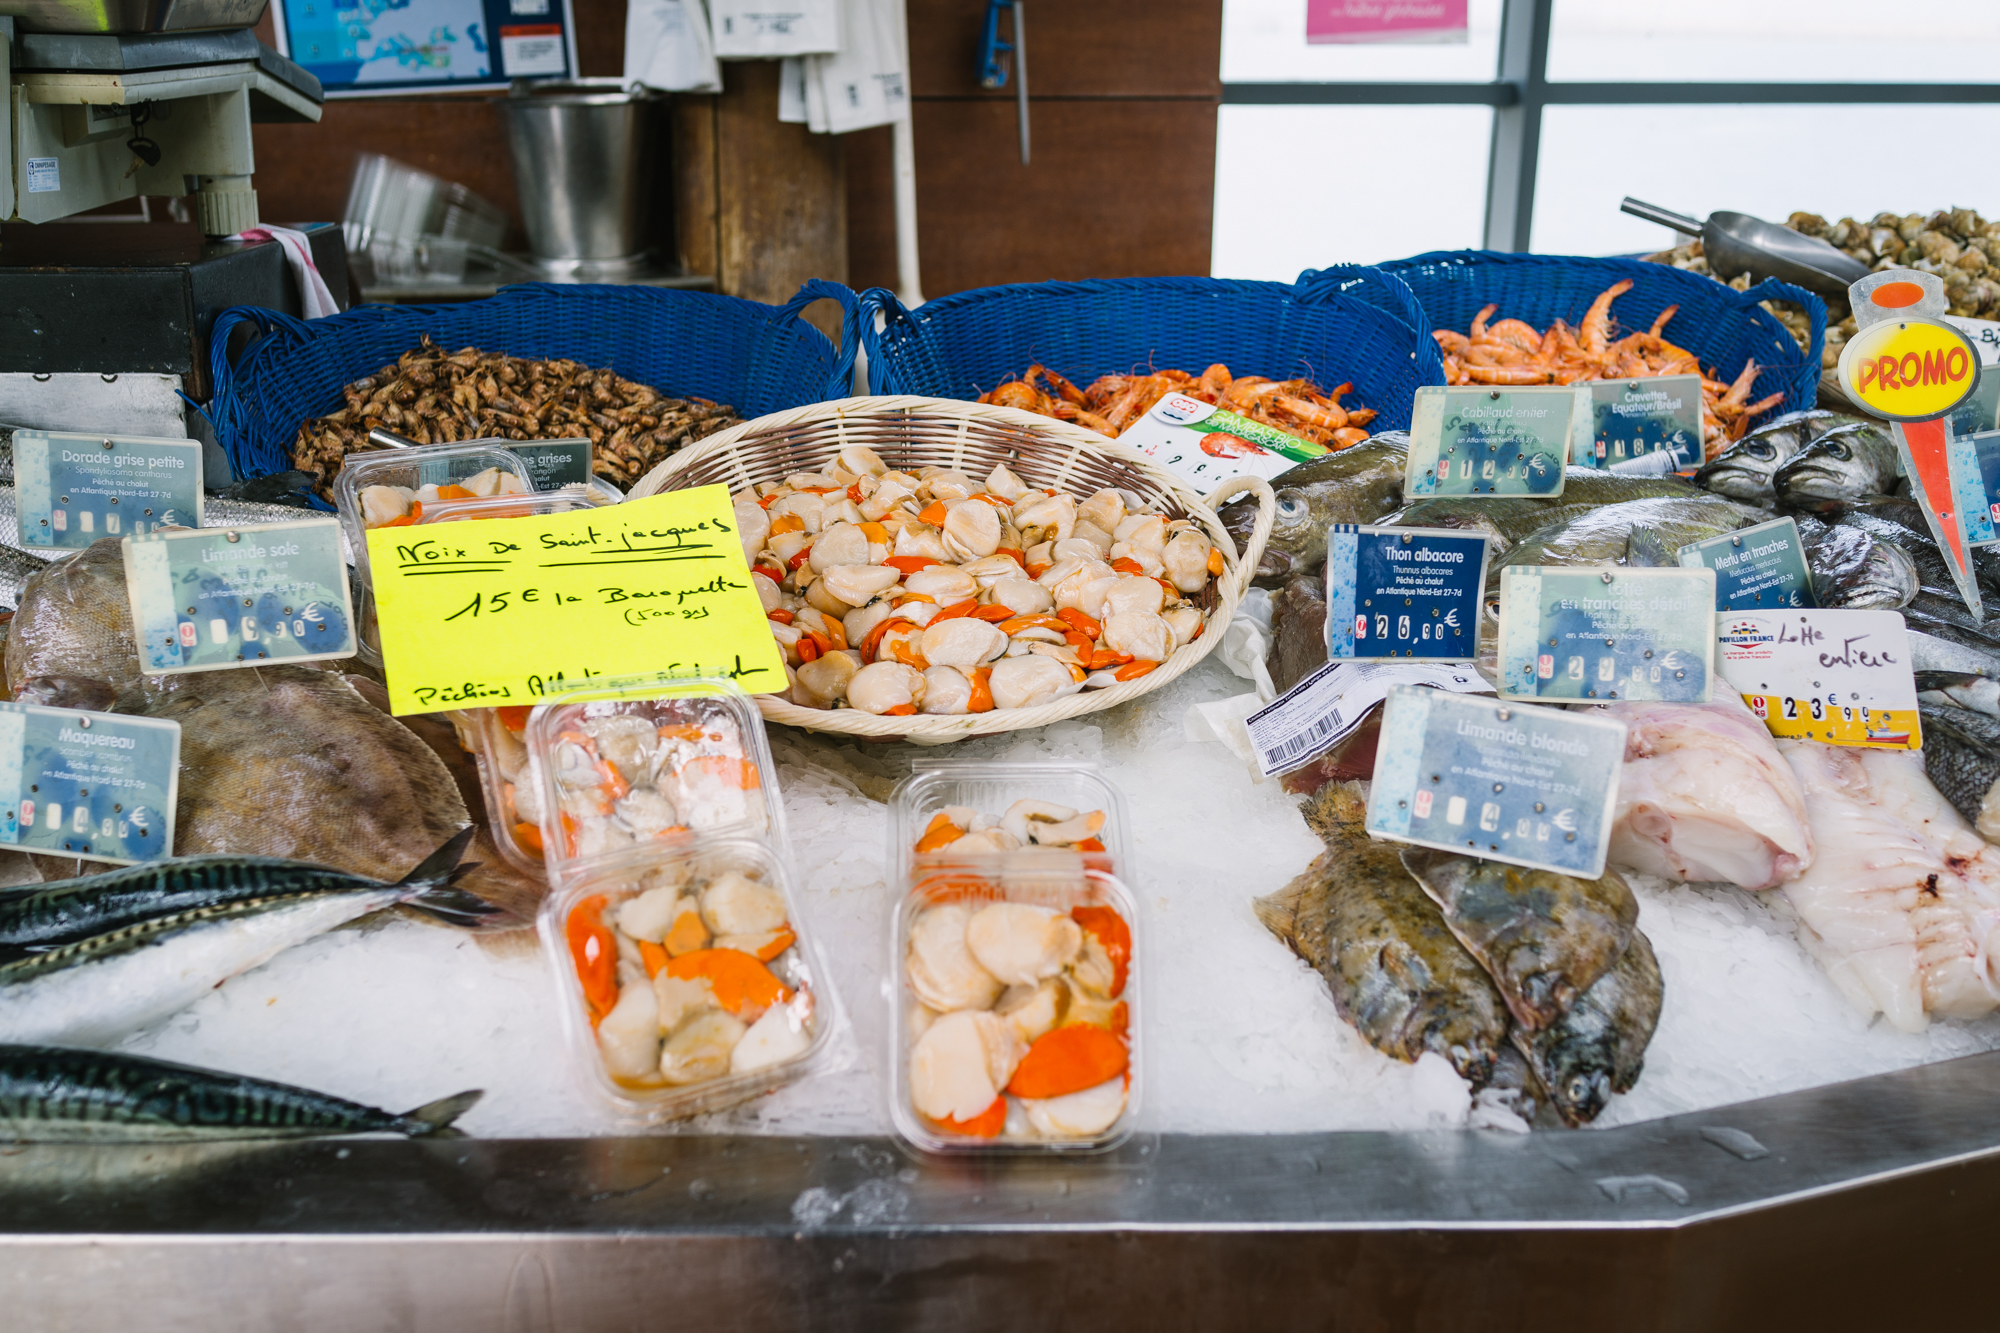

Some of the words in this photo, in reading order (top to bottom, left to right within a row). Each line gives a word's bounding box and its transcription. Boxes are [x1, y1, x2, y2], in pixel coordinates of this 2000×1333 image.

[1858, 346, 1968, 394] PROMO
[1625, 390, 1668, 403] Crevettes
[1462, 406, 1513, 418] Cabillaud
[1516, 408, 1548, 418] entier
[1612, 398, 1682, 417] Equateur/Brésil
[1212, 411, 1274, 440] GAMBAS
[1274, 434, 1301, 448] BIO
[1218, 423, 1286, 451] MADAGASCAR
[62, 450, 110, 464] Dorade
[114, 453, 144, 468] grise
[148, 456, 184, 470] petite
[538, 453, 572, 466] grises
[76, 466, 133, 476] Spondyliosoma
[134, 470, 172, 478] cantharus
[81, 487, 117, 496] Atlantique
[118, 489, 148, 497] Nord-Est
[202, 544, 266, 562] Limande
[398, 540, 466, 562] Noix
[1385, 546, 1412, 561] Thon
[1414, 547, 1464, 563] albacore
[1714, 552, 1740, 570] Merlu
[1740, 552, 1752, 562] en
[1752, 539, 1788, 559] tranches
[1393, 565, 1420, 574] Thunnus
[1421, 566, 1453, 576] albacares
[1728, 564, 1756, 578] Merluccius
[1756, 556, 1782, 570] merluccius
[1762, 568, 1777, 578] chalut
[1424, 577, 1444, 586] chalut
[1736, 586, 1760, 598] Atlantique
[1760, 578, 1780, 590] Nord-Est
[1780, 573, 1794, 584] 27-7d
[210, 587, 253, 598] Atlantique
[556, 592, 582, 606] la
[1386, 587, 1416, 597] Atlantique
[1416, 588, 1442, 596] Nord-Est
[1444, 588, 1462, 596] 27-7d
[1789, 590, 1803, 608] €
[301, 602, 324, 622] €
[1560, 599, 1578, 610] en
[1583, 596, 1644, 610] tranches
[1649, 596, 1690, 611] détail
[1444, 608, 1460, 627] €
[1578, 632, 1620, 641] Atlantique
[1620, 632, 1656, 640] Nord-Est
[1660, 651, 1683, 670] €
[1540, 666, 1550, 674] kg
[1754, 709, 1766, 718] kg
[58, 728, 136, 750] Maquereau
[1456, 718, 1528, 746] Limande
[1530, 731, 1590, 758] blonde
[53, 770, 91, 782] Atlantique
[101, 764, 124, 774] chalut
[1510, 764, 1524, 773] au
[1524, 765, 1554, 778] chalut
[1450, 766, 1463, 774] en
[1464, 766, 1511, 783] Atlantique
[1512, 776, 1552, 790] Nord-Est
[129, 806, 150, 827] €
[1552, 808, 1577, 831] €
